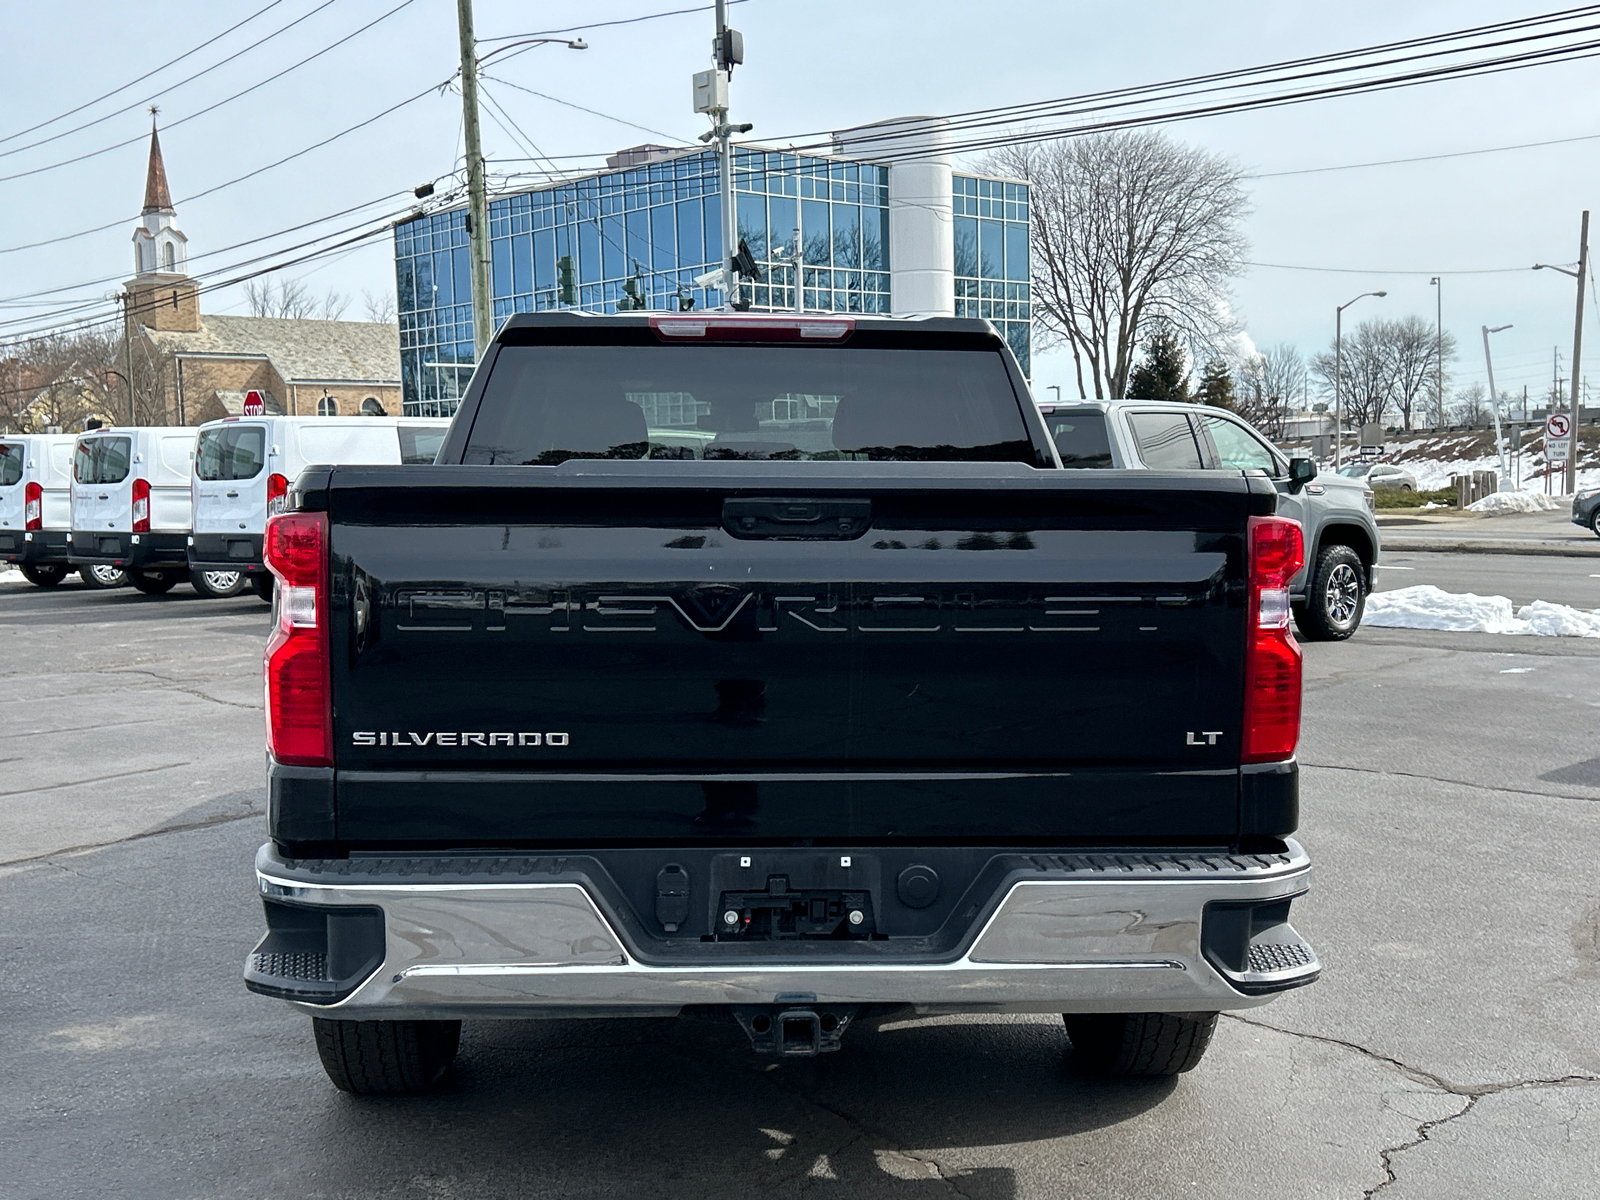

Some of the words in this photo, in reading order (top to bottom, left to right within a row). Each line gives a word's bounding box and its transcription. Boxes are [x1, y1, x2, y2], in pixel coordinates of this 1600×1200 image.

[245, 404, 263, 416] STOP
[395, 590, 1188, 632] CHEVROLET
[352, 731, 570, 747] SILVERADO
[1186, 731, 1223, 745] LT
